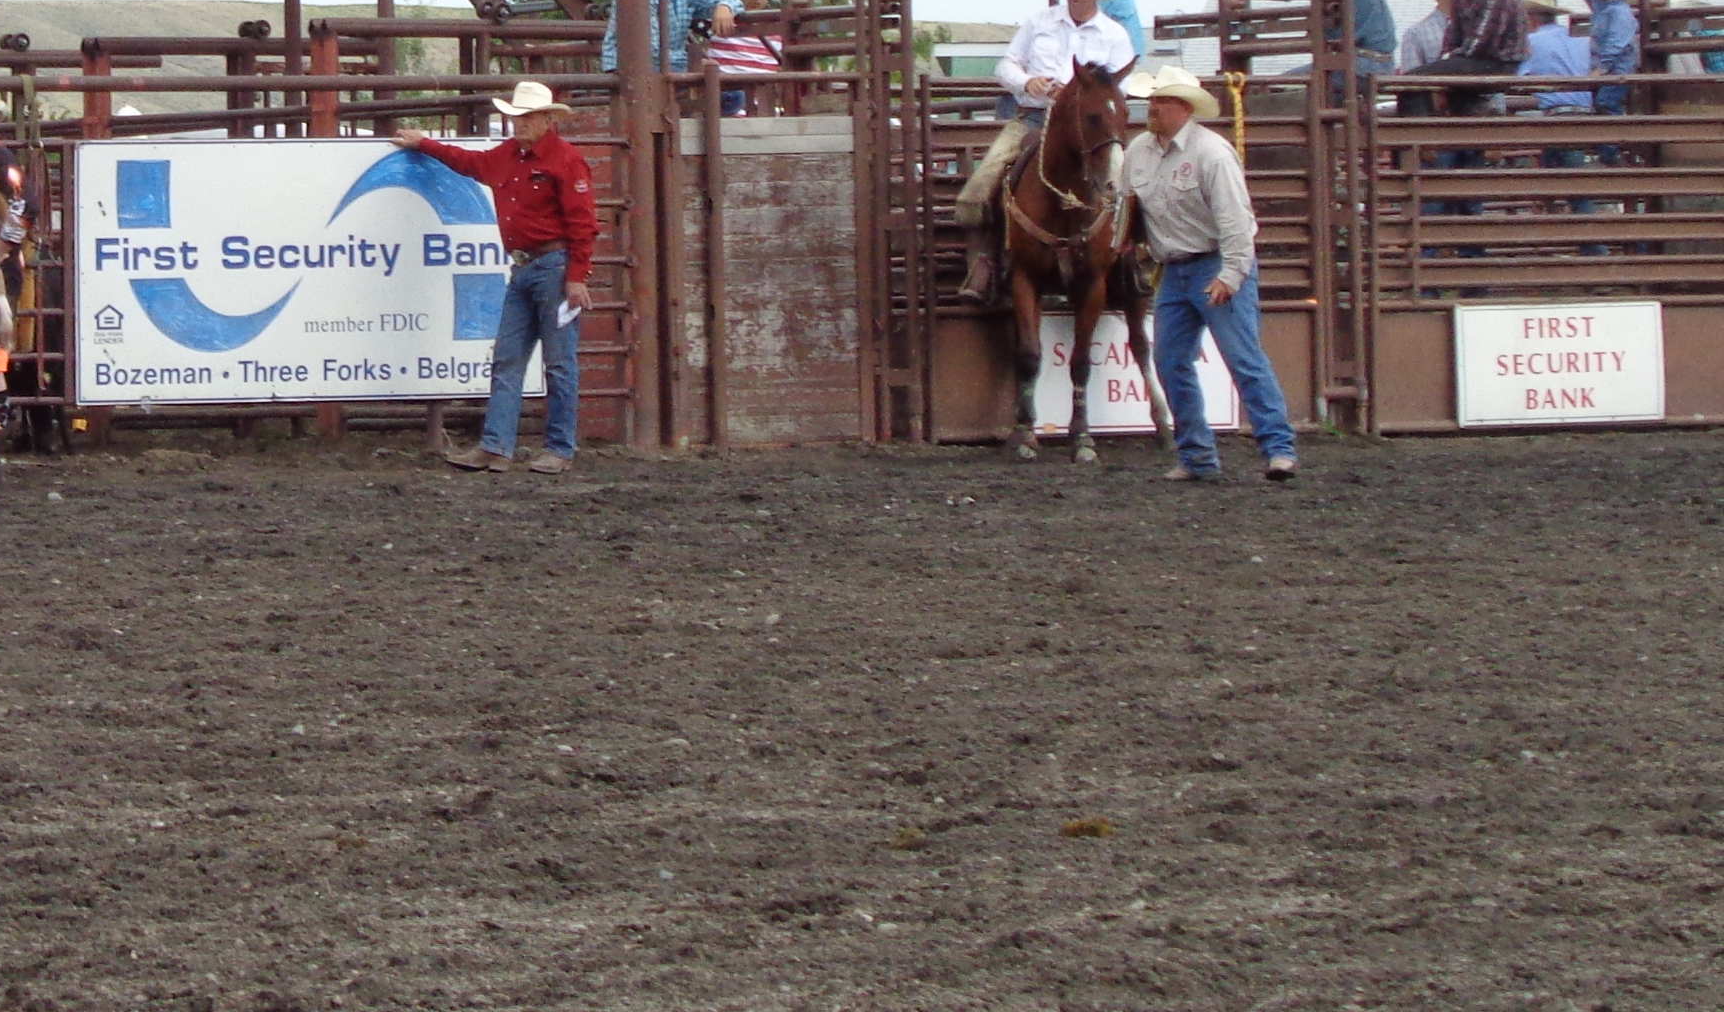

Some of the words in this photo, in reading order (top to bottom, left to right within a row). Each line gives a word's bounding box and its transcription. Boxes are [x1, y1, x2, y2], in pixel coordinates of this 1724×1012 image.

[94, 236, 198, 272] First
[220, 234, 402, 277] Security
[303, 314, 373, 334] member
[379, 312, 429, 333] FDIC
[1523, 316, 1596, 339] FIRST
[95, 362, 212, 386] Bozeman
[237, 359, 308, 383] Three
[322, 358, 393, 382] Forks
[417, 355, 494, 384] Belgra
[1496, 350, 1627, 376] SECURITY
[1525, 387, 1596, 410] BANK
